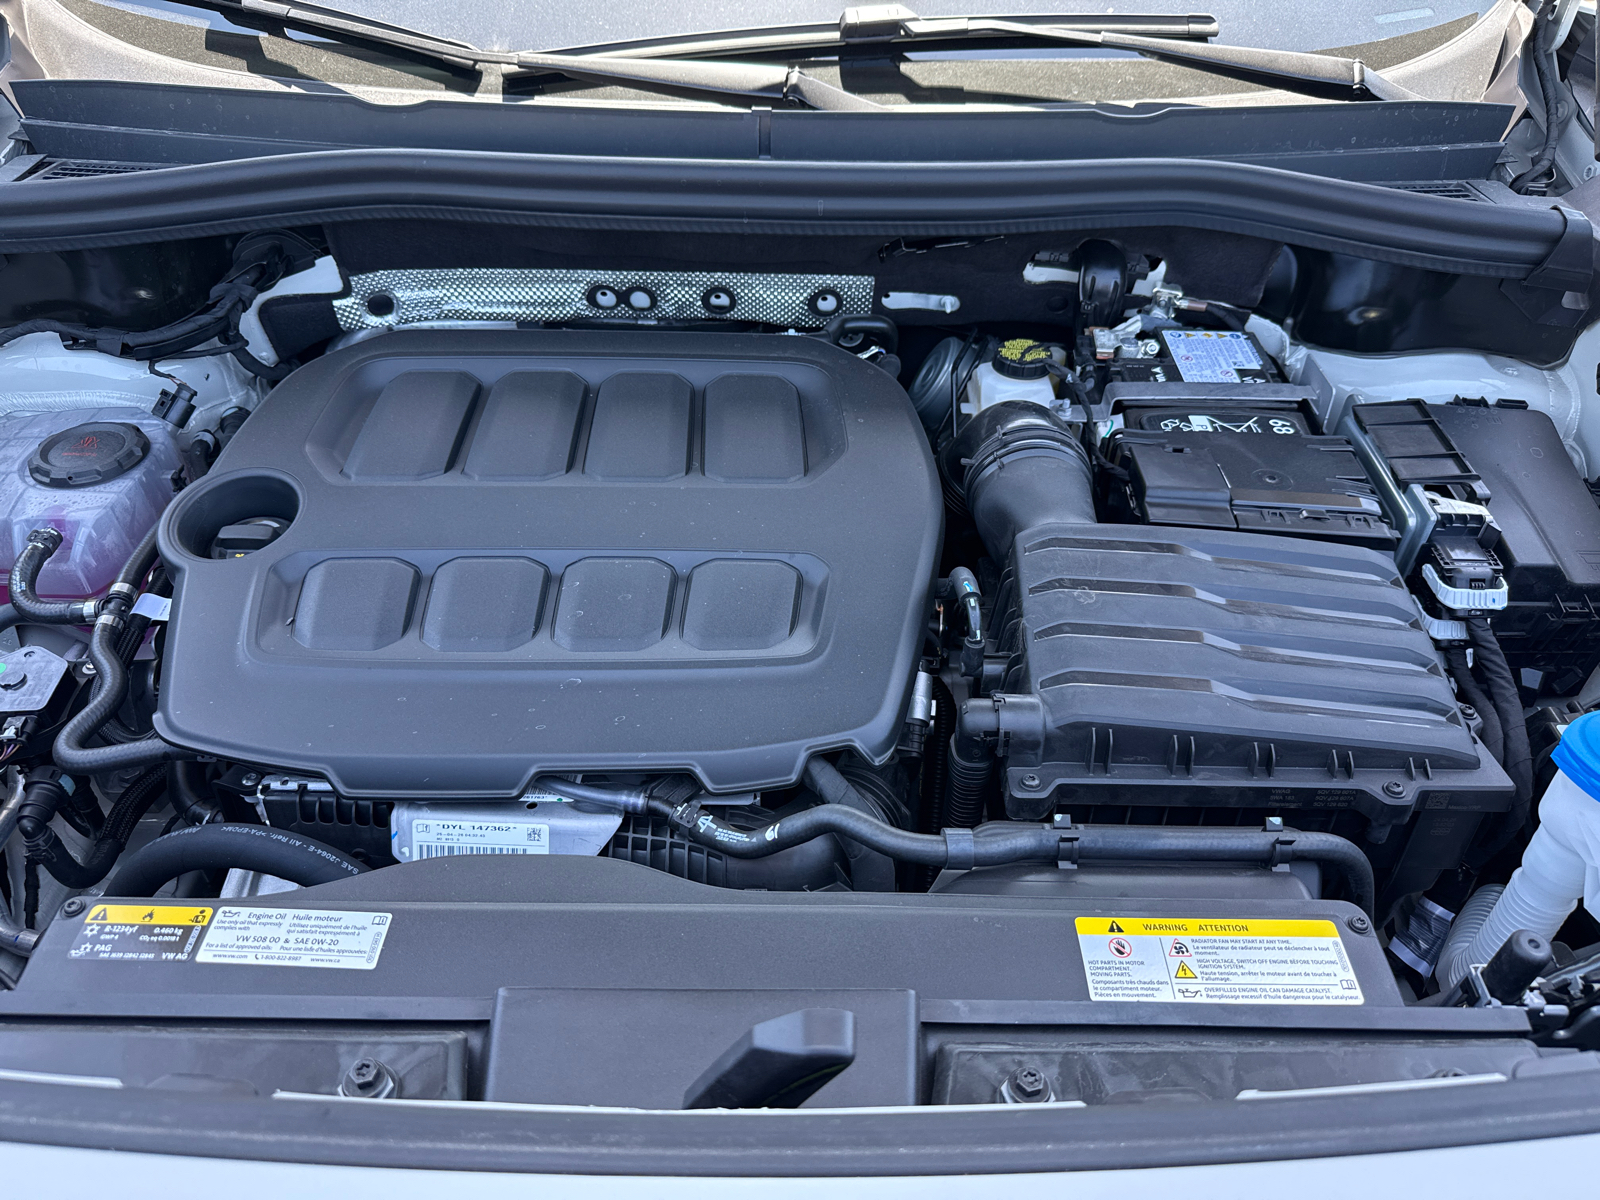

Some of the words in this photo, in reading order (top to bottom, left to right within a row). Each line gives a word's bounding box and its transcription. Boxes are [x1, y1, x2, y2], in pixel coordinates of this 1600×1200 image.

[289, 838, 302, 848] All
[341, 861, 359, 875] SAE
[247, 912, 274, 921] Engine
[292, 913, 313, 921] Huile
[104, 925, 139, 934] R-1234yf
[174, 927, 184, 936] kg
[1142, 923, 1188, 932] WARNING
[1198, 924, 1249, 932] ATTENTION
[268, 936, 280, 944] 00
[294, 937, 310, 945] SAE
[94, 944, 112, 952] PAG
[161, 952, 175, 960] VW
[175, 952, 188, 960] AG
